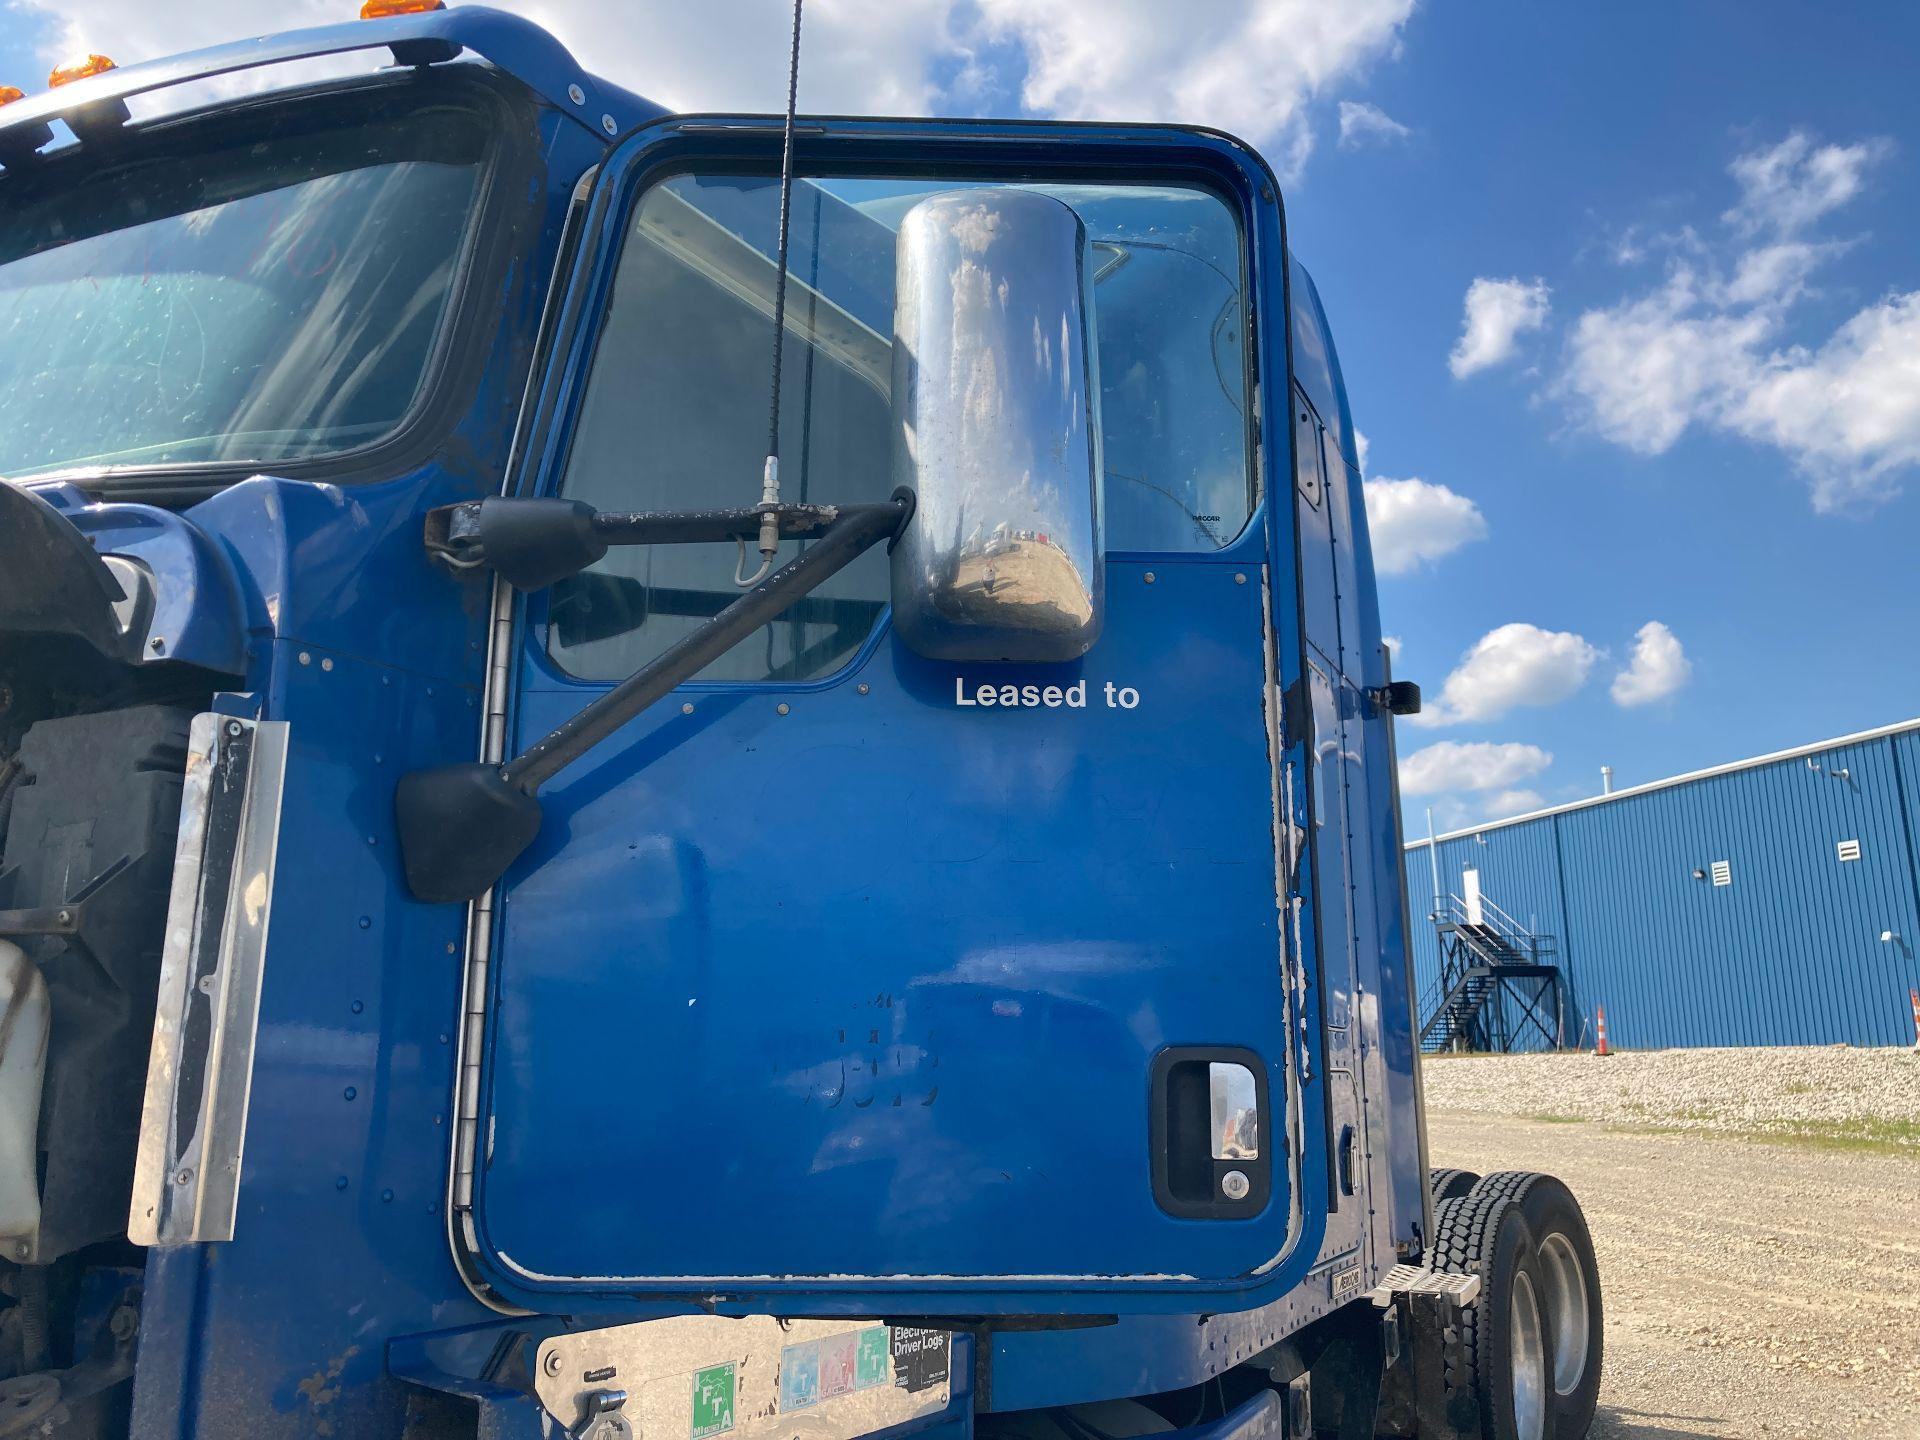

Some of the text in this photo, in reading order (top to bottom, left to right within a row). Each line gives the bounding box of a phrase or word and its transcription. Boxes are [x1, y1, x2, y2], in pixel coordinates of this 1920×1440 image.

[955, 677, 1140, 709] Leased to
[894, 1335, 944, 1356] Driver Logs
[724, 1365, 734, 1377] 23
[694, 1373, 732, 1429] IFTA
[693, 1425, 704, 1437] MI
